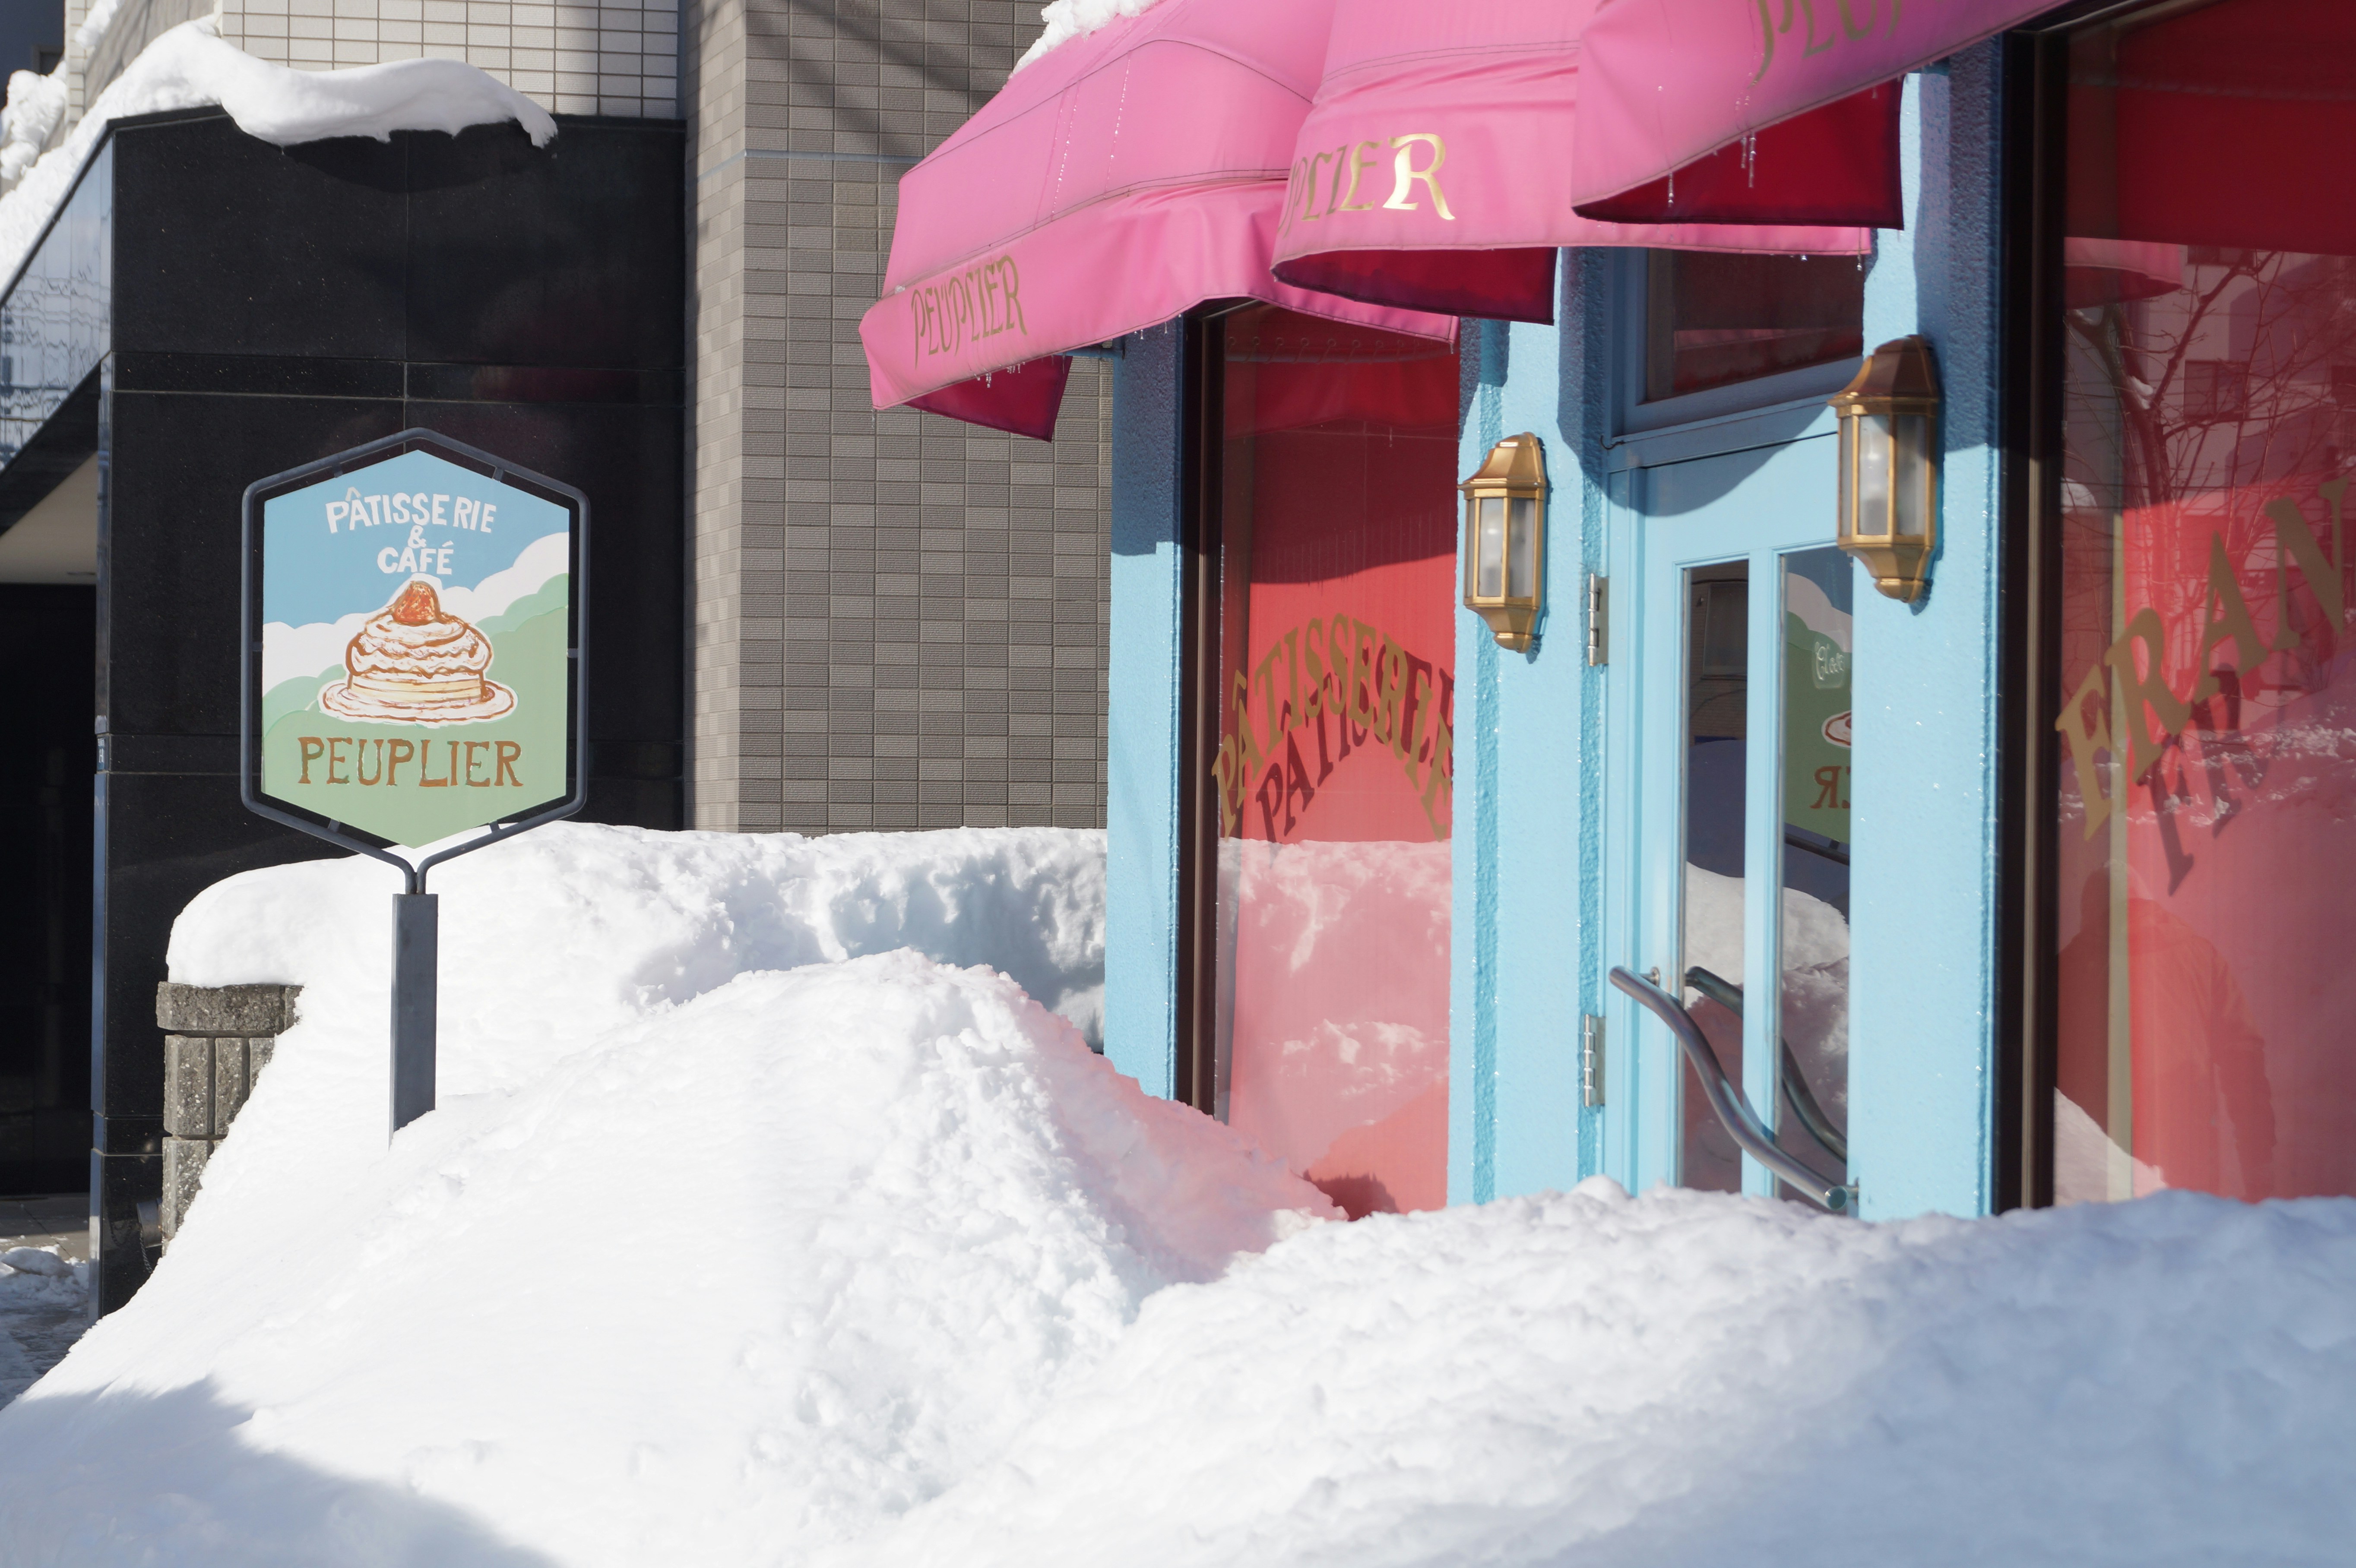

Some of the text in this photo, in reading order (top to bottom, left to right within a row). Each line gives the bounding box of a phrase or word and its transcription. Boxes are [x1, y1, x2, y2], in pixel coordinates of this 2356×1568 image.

[911, 255, 1027, 370] PEUPLIER
[326, 486, 496, 534] PÂTISSERIE
[377, 541, 453, 575] CAFÉ
[408, 524, 426, 549] &
[298, 737, 523, 787] PEUPLIER
